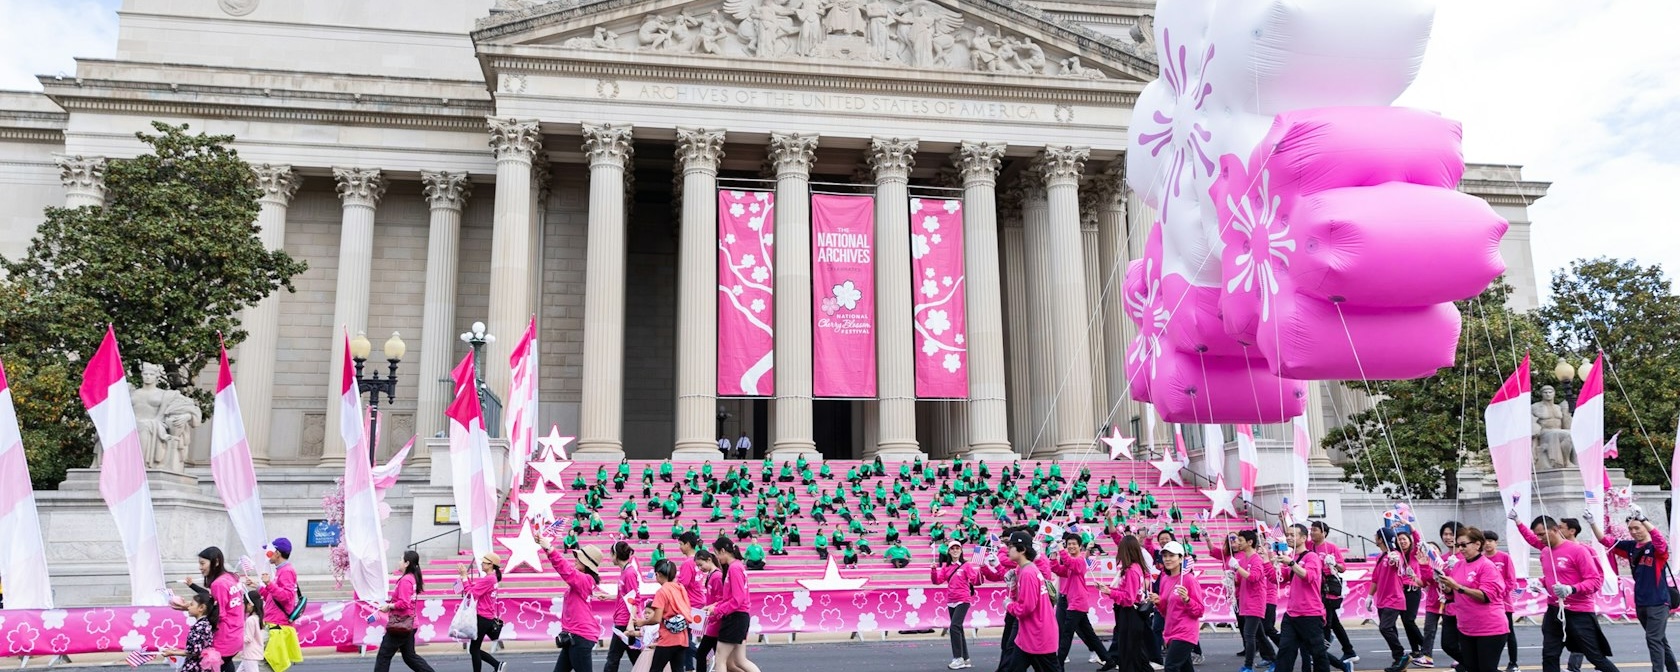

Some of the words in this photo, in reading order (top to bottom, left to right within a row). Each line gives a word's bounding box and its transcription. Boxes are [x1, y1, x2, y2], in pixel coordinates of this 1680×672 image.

[639, 86, 729, 102] ARCHIVES
[736, 90, 756, 104] OF
[762, 92, 795, 107] THE
[802, 95, 866, 110] UNITED
[872, 98, 929, 113] STATES
[935, 101, 955, 115] OF
[960, 103, 1038, 119] AMERICA
[818, 233, 870, 248] NATIONAL
[818, 248, 870, 263] ARCHIVES
